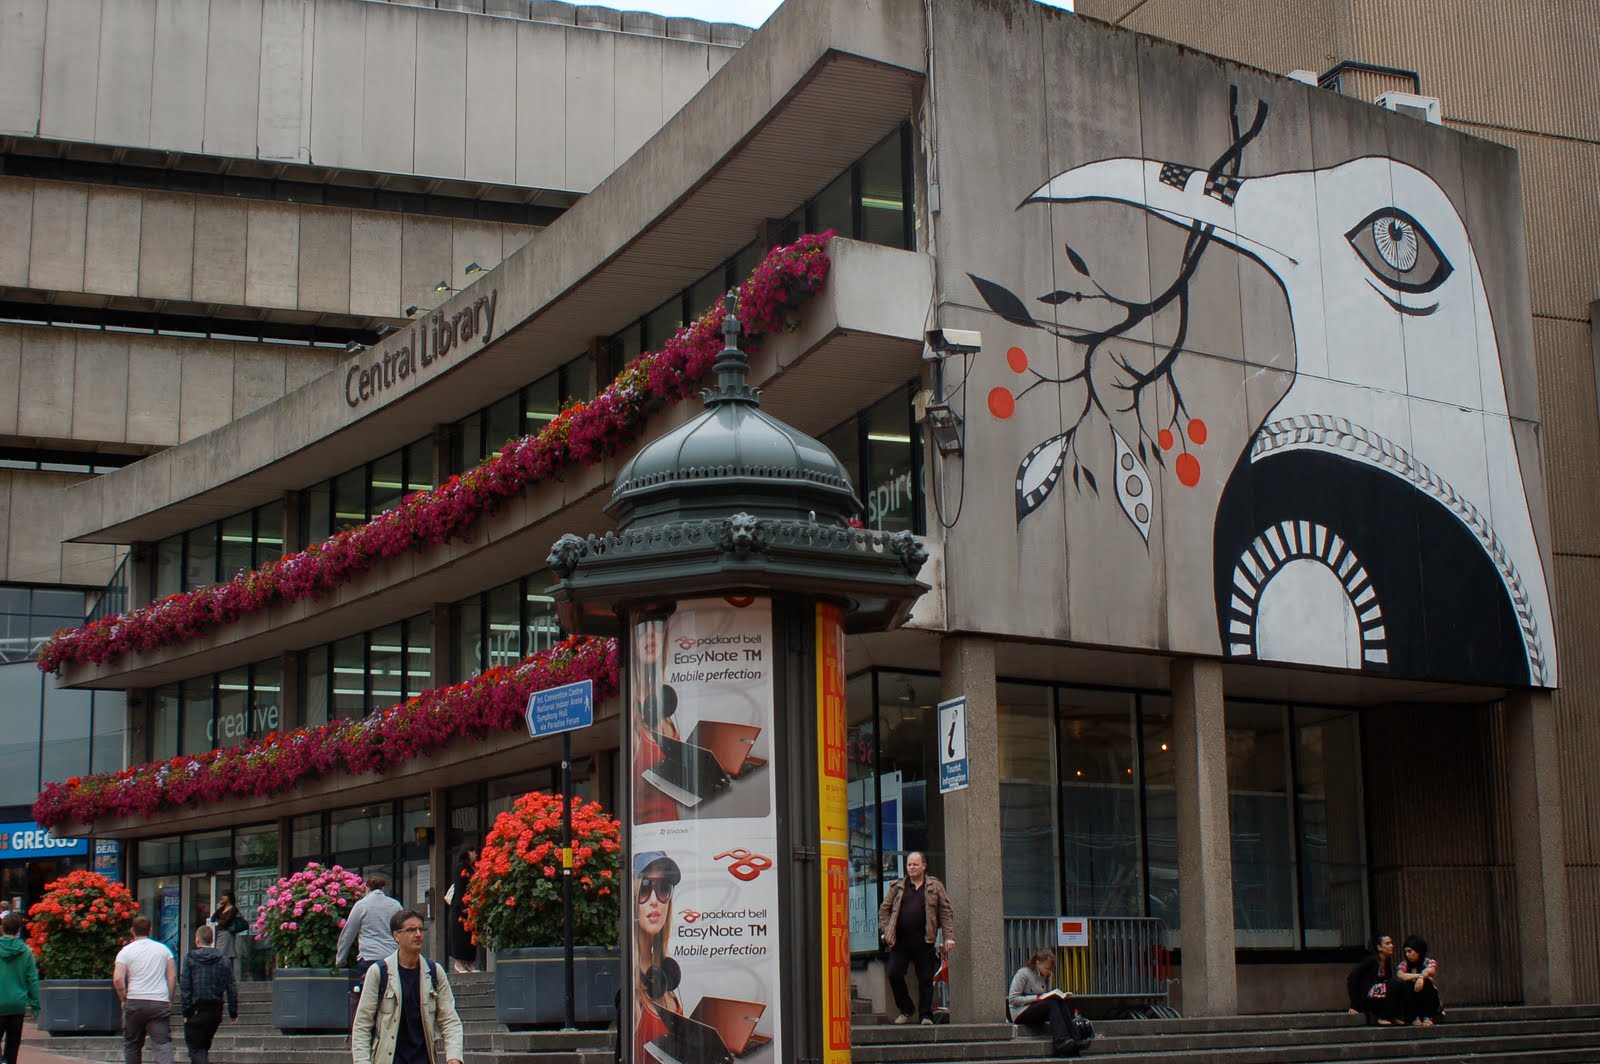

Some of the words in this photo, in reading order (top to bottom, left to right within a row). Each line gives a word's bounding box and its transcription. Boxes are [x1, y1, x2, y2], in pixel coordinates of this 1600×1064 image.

[345, 327, 416, 408] Central
[421, 288, 497, 368] Library
[697, 635, 741, 647] packard
[743, 634, 762, 645] bell
[674, 650, 738, 665] EasyNote
[743, 649, 762, 662] TM
[670, 669, 704, 683] Mobile
[705, 668, 761, 683] perfection
[544, 691, 568, 702] Convention
[568, 687, 583, 697] Centre
[536, 703, 555, 713] National
[555, 700, 570, 709] Indoor
[570, 697, 583, 705] Arena
[536, 712, 558, 723] Symphony
[558, 708, 568, 717] Hall
[547, 719, 566, 730] Paradise
[566, 717, 580, 726] Forum
[946, 763, 962, 774] Tourist
[942, 774, 967, 786] Information
[95, 845, 118, 854] DEAL
[701, 909, 745, 921] packard
[748, 909, 767, 919] bell
[677, 924, 743, 940] EasyNote
[748, 925, 767, 937] TM
[849, 917, 877, 936] ibrary
[673, 944, 708, 956] Mobile
[709, 944, 767, 958] perfection
